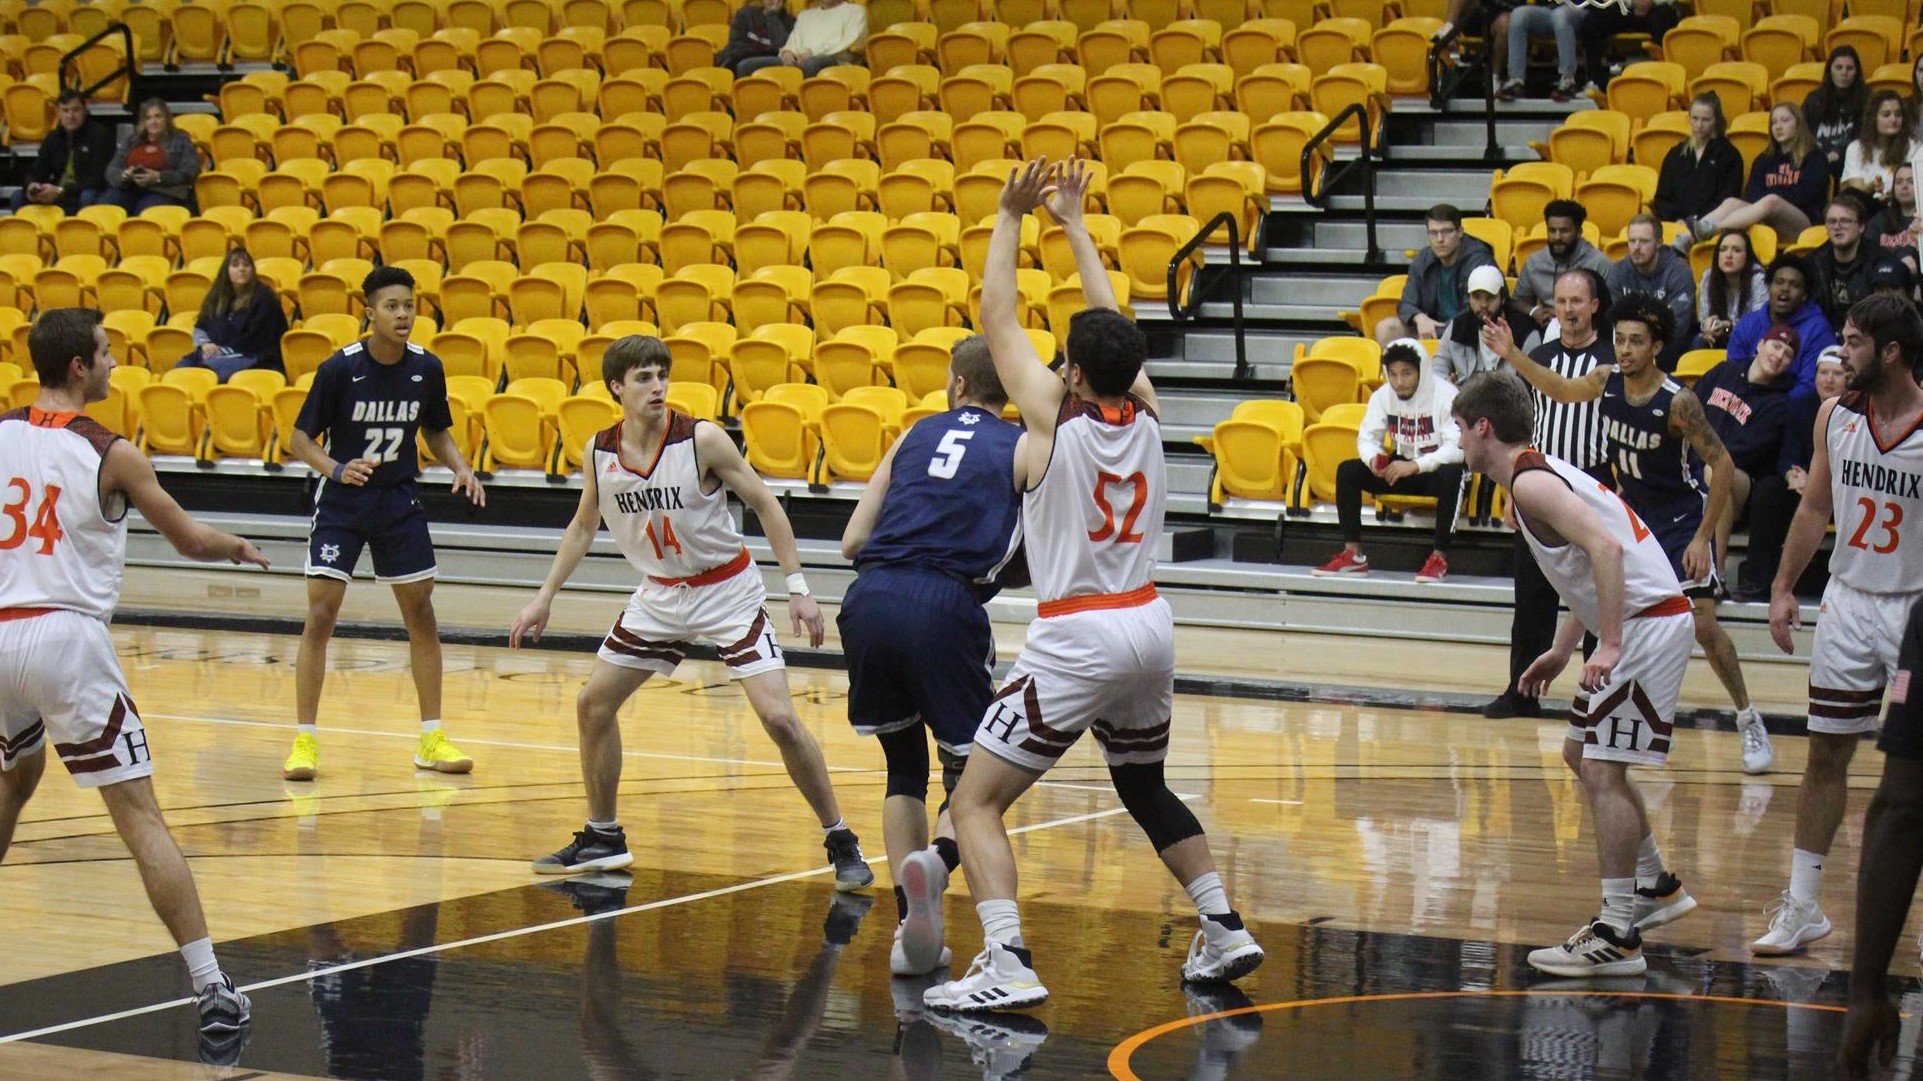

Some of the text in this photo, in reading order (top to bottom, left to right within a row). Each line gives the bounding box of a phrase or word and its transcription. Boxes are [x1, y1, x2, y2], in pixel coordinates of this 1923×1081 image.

[351, 401, 421, 422] DALLAS
[362, 427, 404, 463] 22
[927, 429, 976, 480] 5
[1619, 448, 1643, 480] 11
[1841, 459, 1922, 499] HENDRIX
[0, 477, 63, 555] 34
[614, 486, 684, 514] HENDRIX
[1087, 471, 1148, 543] 52
[645, 515, 683, 560] 14
[1847, 497, 1904, 555] 23
[984, 701, 1024, 745] H
[1605, 716, 1643, 752] H
[122, 728, 151, 766] H
